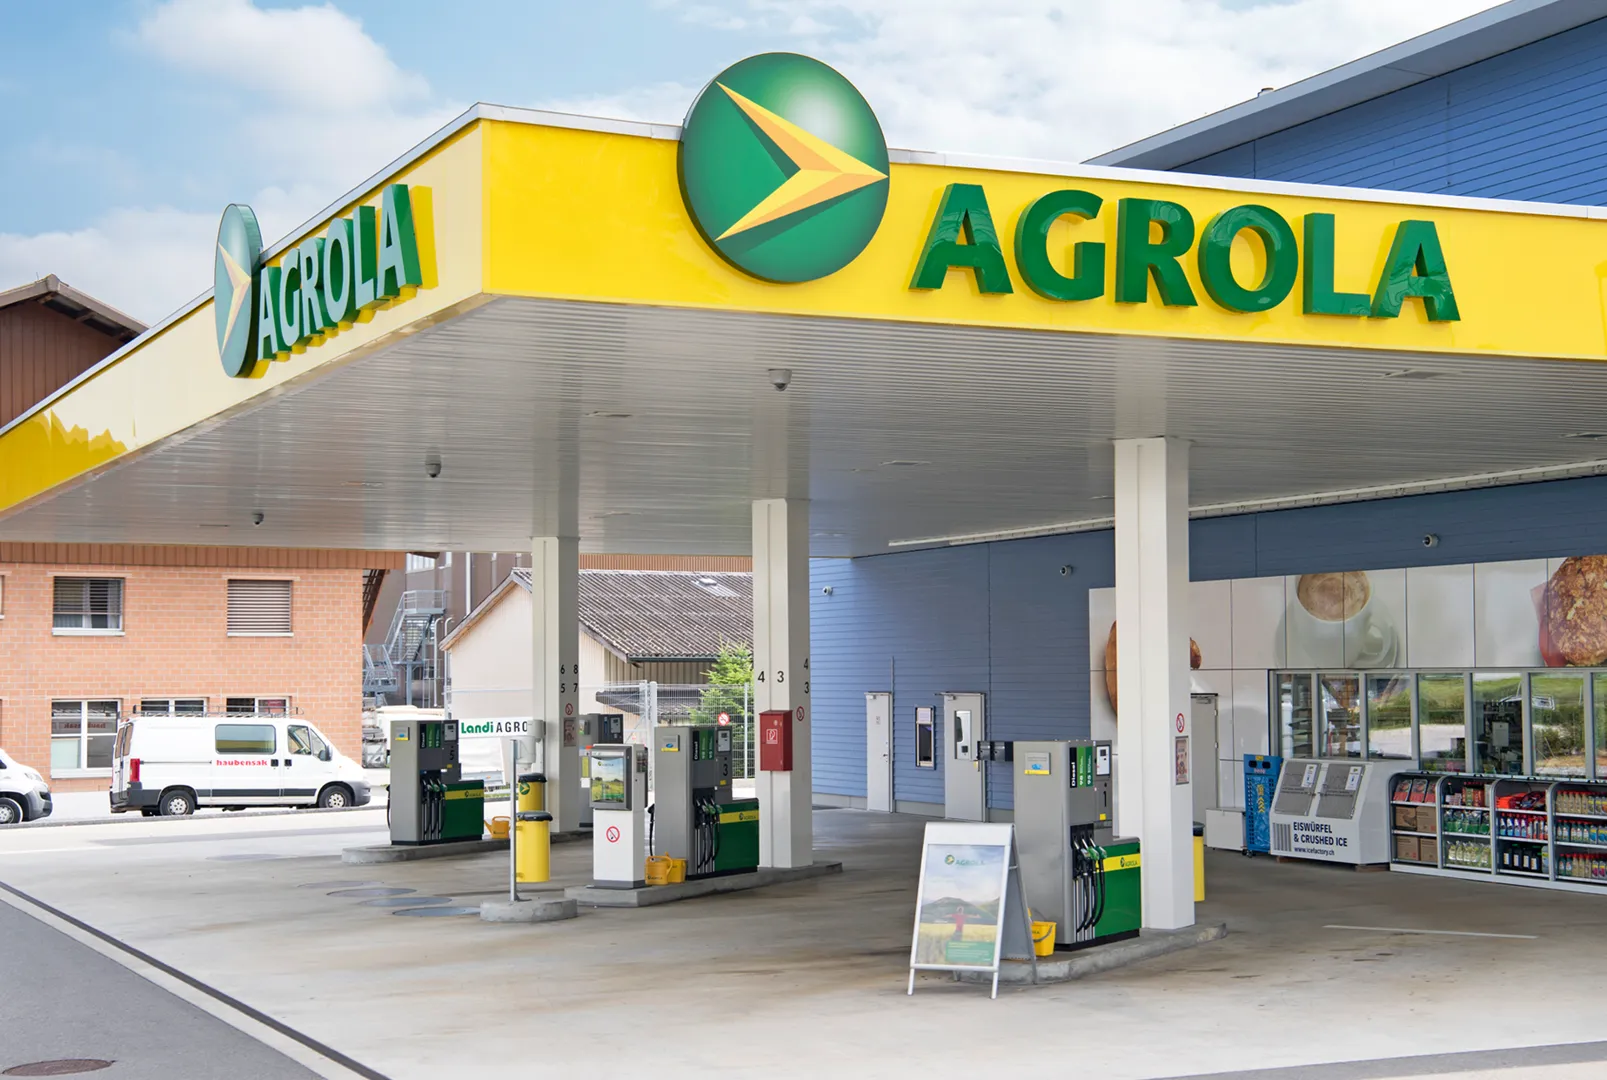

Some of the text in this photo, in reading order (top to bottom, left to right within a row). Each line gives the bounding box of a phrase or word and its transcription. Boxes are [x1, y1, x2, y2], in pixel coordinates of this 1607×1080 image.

[909, 183, 1461, 322] AGROLA
[257, 184, 422, 361] AGROLA
[560, 664, 579, 674] 6 8
[803, 658, 809, 670] 4
[757, 670, 784, 683] 4 3
[560, 683, 578, 693] 5 7
[804, 681, 810, 694] 3
[461, 721, 494, 734] Landi
[449, 750, 455, 760] 5
[722, 763, 728, 777] 3
[1293, 821, 1333, 834] EISWÜRFEL
[1293, 833, 1348, 847] & CRUSHED ICE
[1294, 847, 1335, 856] www.icefactory.ch
